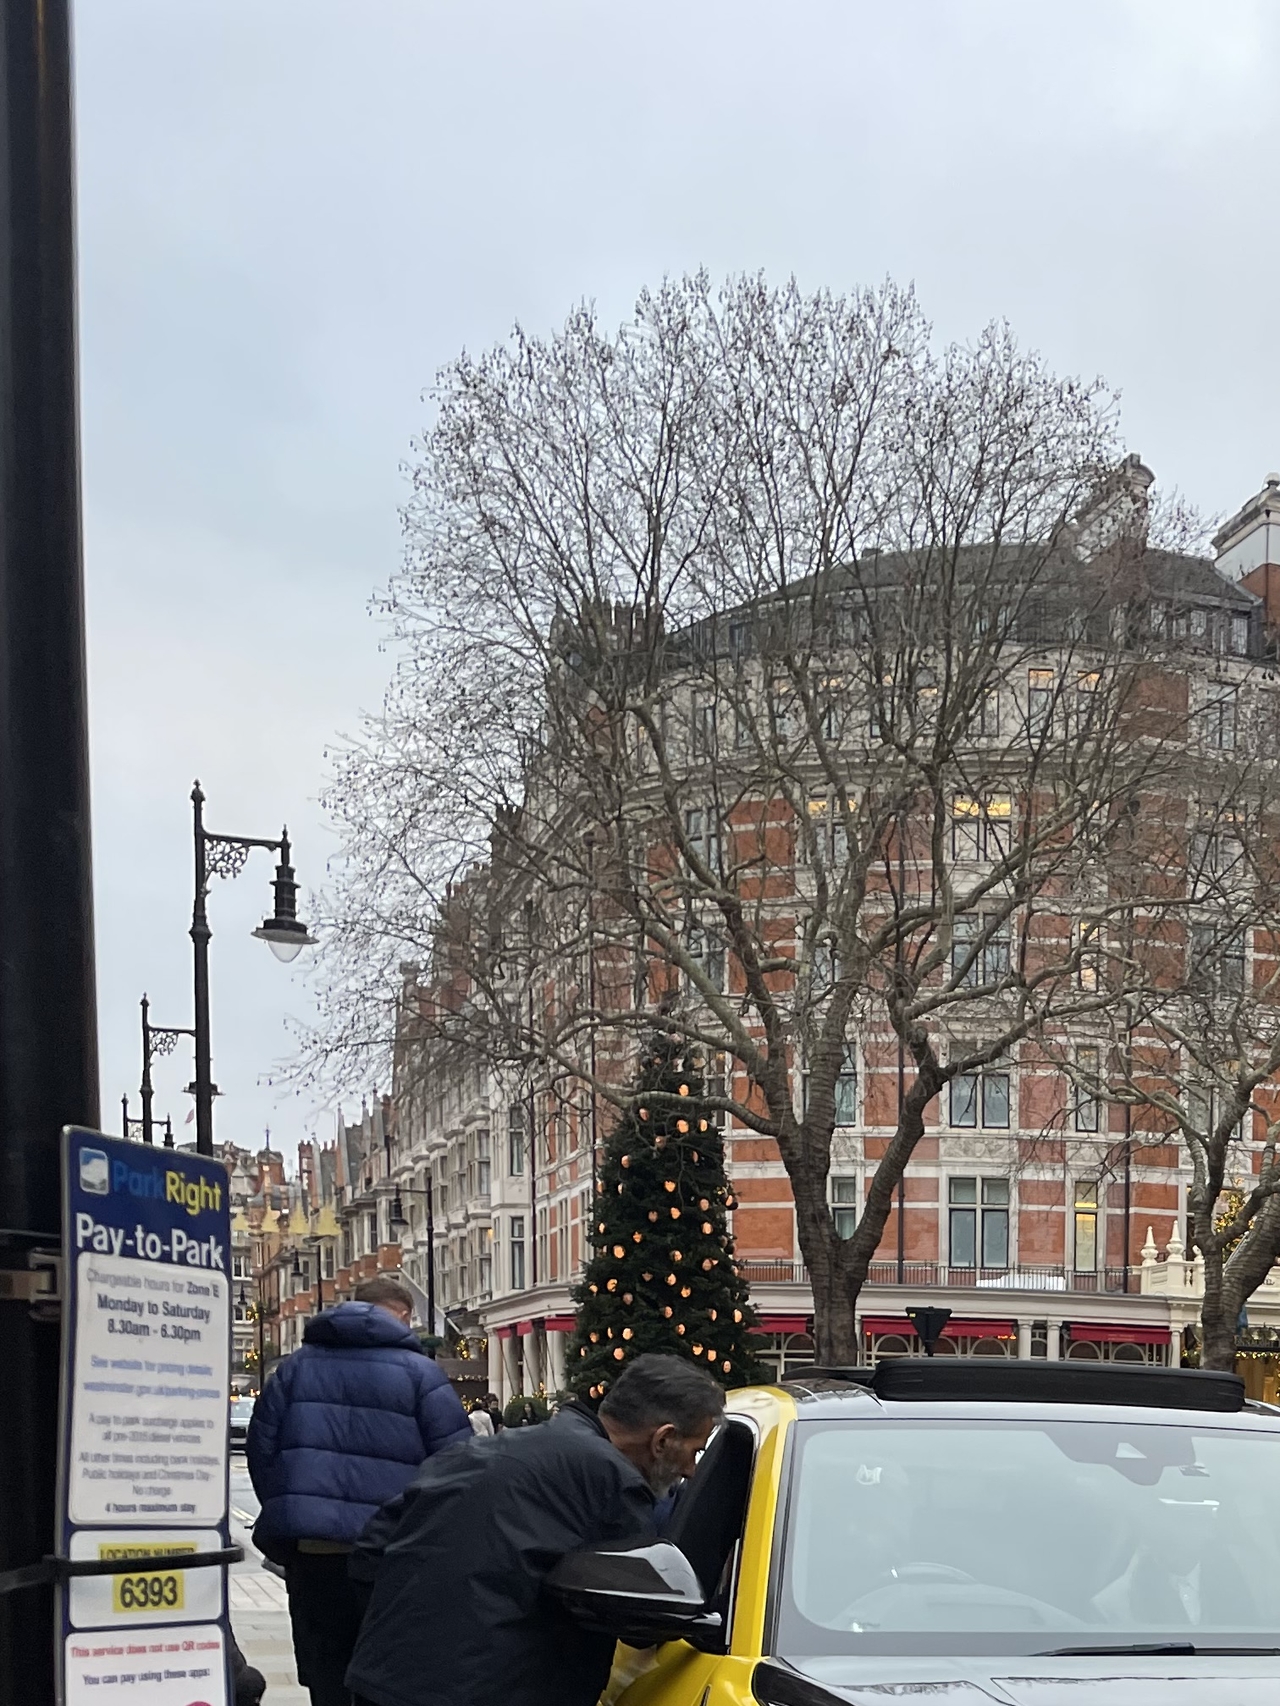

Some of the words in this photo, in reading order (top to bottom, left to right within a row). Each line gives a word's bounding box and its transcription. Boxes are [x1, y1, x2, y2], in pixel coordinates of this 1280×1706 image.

[113, 1160, 221, 1215] ParkRight
[76, 1212, 224, 1269] Pay-to-Park
[187, 1281, 210, 1296] Zone
[212, 1284, 219, 1298] E
[97, 1294, 144, 1317] Monday
[148, 1301, 159, 1315] to
[162, 1301, 210, 1324] Saturday
[108, 1319, 150, 1336] 8.30am
[161, 1324, 201, 1345] 6.30pm
[120, 1576, 177, 1608] 6393
[181, 1641, 194, 1651] QR
[82, 1674, 99, 1685] You
[102, 1674, 117, 1684] can
[120, 1673, 135, 1684] pay
[138, 1670, 162, 1682] using
